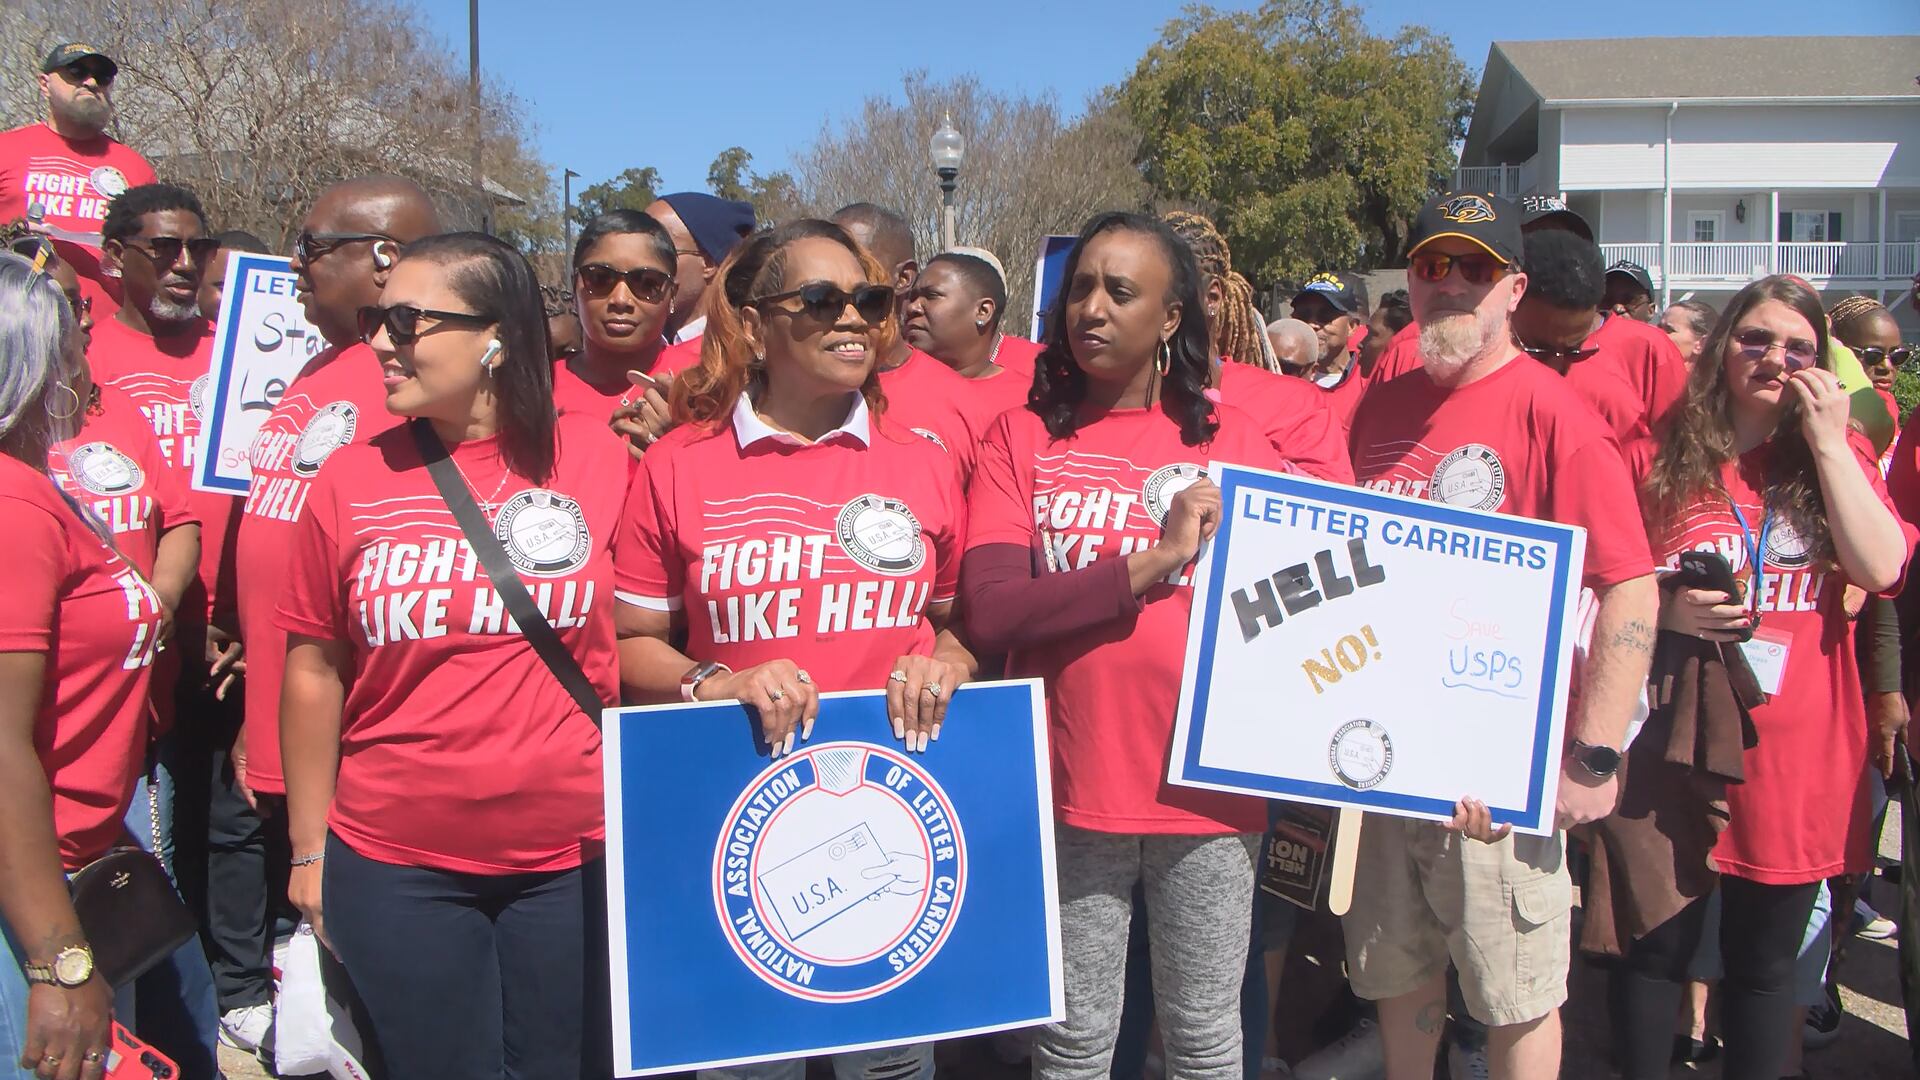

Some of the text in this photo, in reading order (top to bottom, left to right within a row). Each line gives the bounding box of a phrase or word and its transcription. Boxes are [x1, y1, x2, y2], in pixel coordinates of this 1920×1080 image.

[25, 172, 90, 196] FIGHT
[253, 275, 297, 297] LET
[500, 498, 528, 541] ASSOCIATION
[842, 501, 865, 539] ASSOCIATION
[1243, 494, 1547, 570] LETTER CARRIERS
[357, 538, 479, 597] FIGHT
[701, 534, 832, 594] FIGHT
[1230, 537, 1386, 644] HELL
[359, 588, 453, 648] LIKE
[707, 579, 931, 644] LIKE HELL!
[1301, 624, 1382, 694] NO!
[1449, 644, 1522, 688] USPS
[727, 765, 956, 985] NATIONAL ASSOCIATION OF LETTER CARRIERS
[792, 877, 848, 915] U.S.A.
